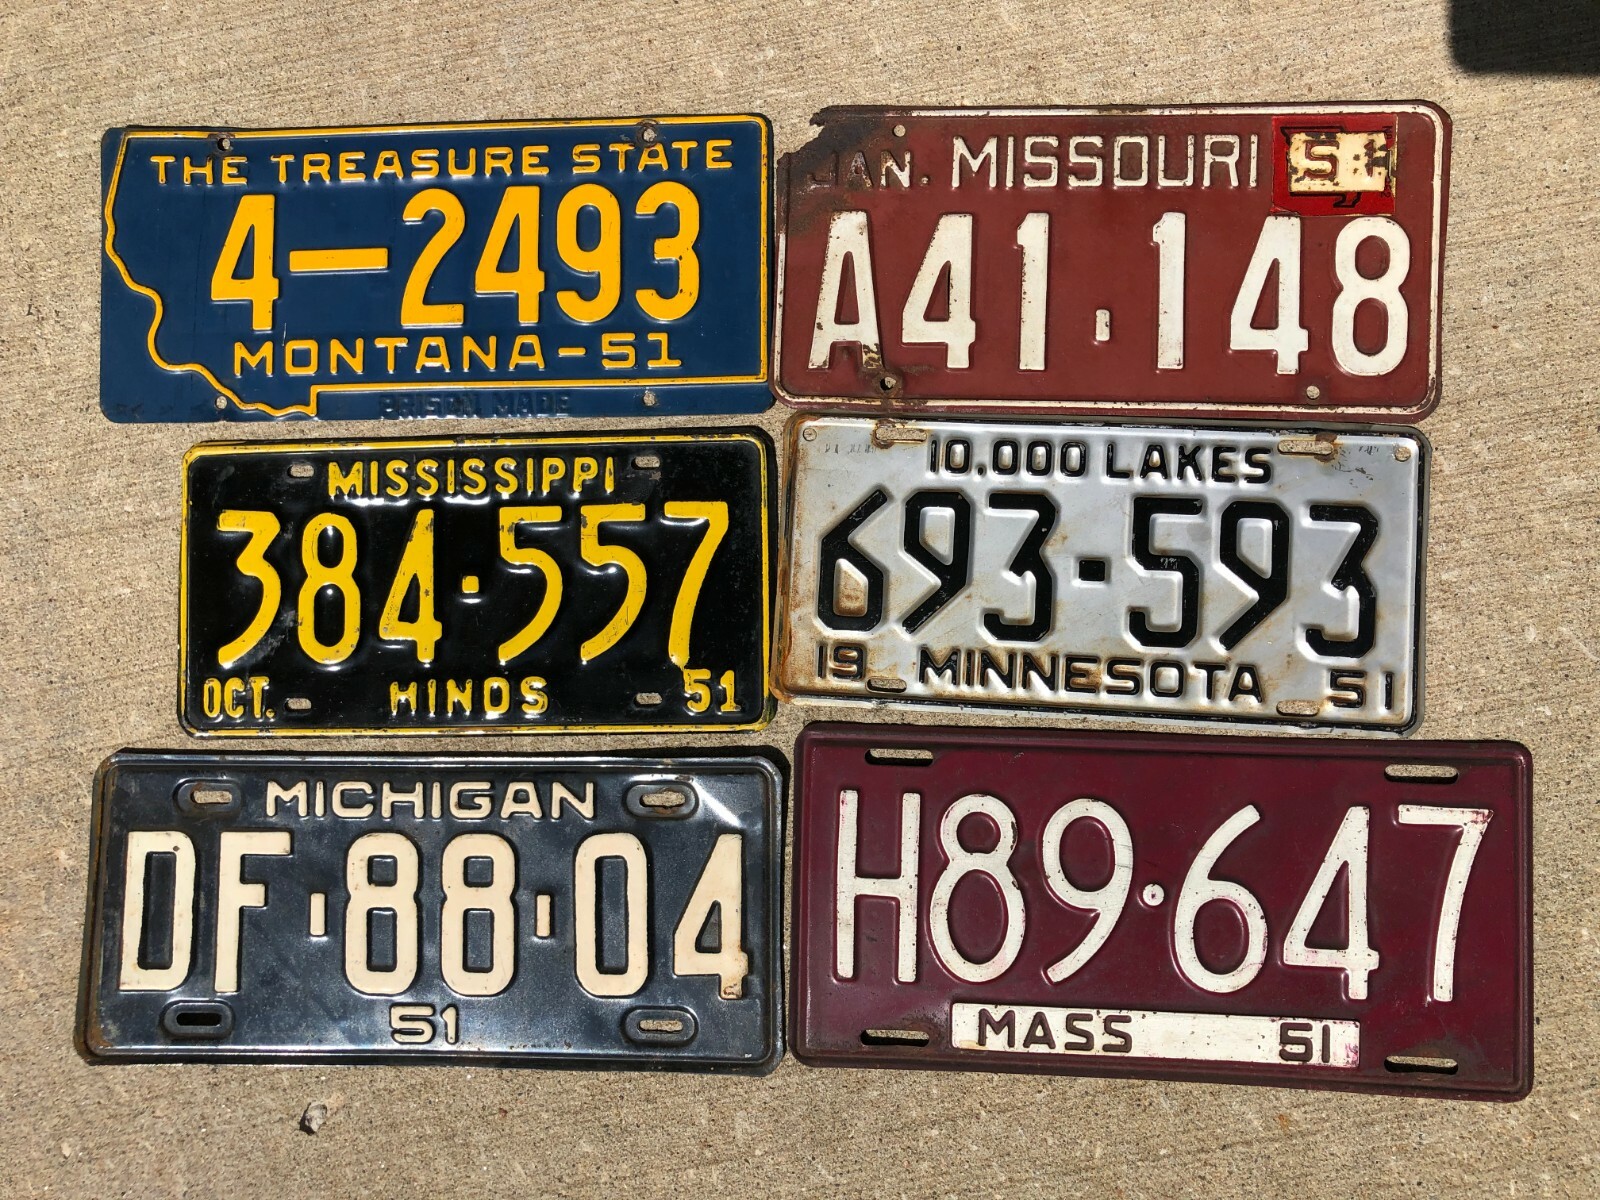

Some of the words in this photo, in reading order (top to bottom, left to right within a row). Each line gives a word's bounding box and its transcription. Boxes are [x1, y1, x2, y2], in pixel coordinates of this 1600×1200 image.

[150, 152, 249, 187] THE
[271, 144, 550, 185] TREASURE
[571, 139, 733, 175] STATE
[951, 132, 1259, 190] MISSOURI
[379, 391, 482, 419] PRISON
[491, 390, 571, 418] MADE
[327, 456, 615, 498] MISSISSIPPI
[1104, 442, 1274, 485] LAKES
[203, 675, 276, 719] OCT.
[389, 675, 549, 718] HINDS
[682, 667, 740, 714] 51
[816, 643, 868, 681] 19
[918, 645, 1265, 706] MINNESOTA
[1328, 668, 1395, 712] 51
[264, 780, 596, 820] MICHIGAN
[388, 1004, 459, 1045] 51
[977, 1008, 1134, 1055] MASS
[1278, 1022, 1332, 1064] 51
